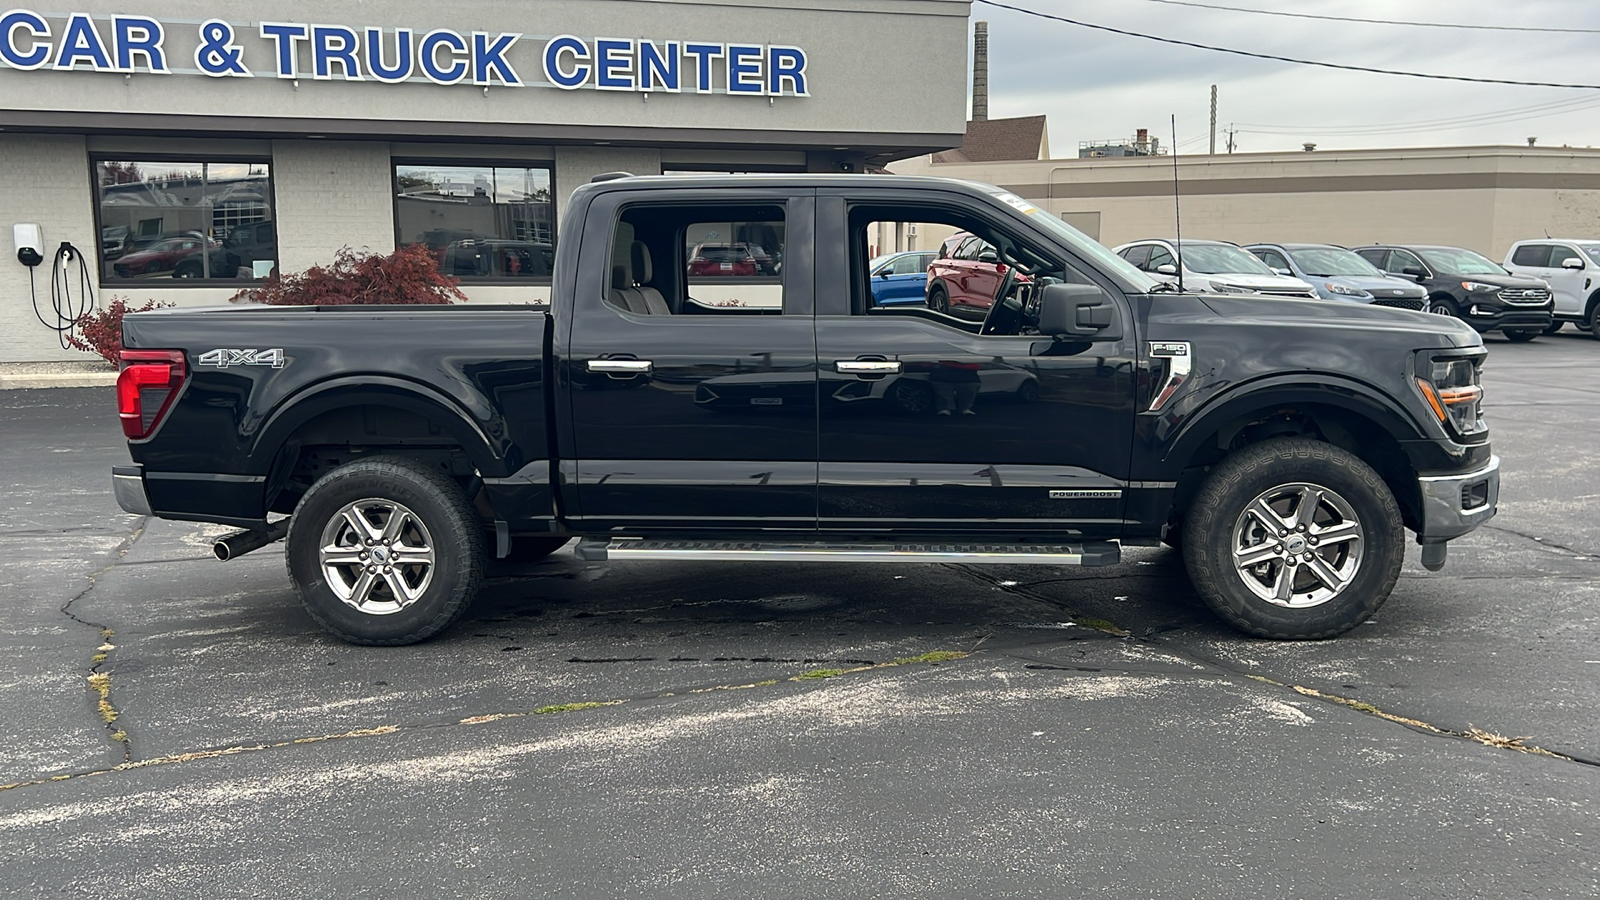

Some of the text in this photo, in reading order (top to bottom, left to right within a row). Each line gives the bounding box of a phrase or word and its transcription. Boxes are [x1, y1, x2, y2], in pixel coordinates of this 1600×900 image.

[0, 9, 811, 98] CAR & TRUCK CENTER
